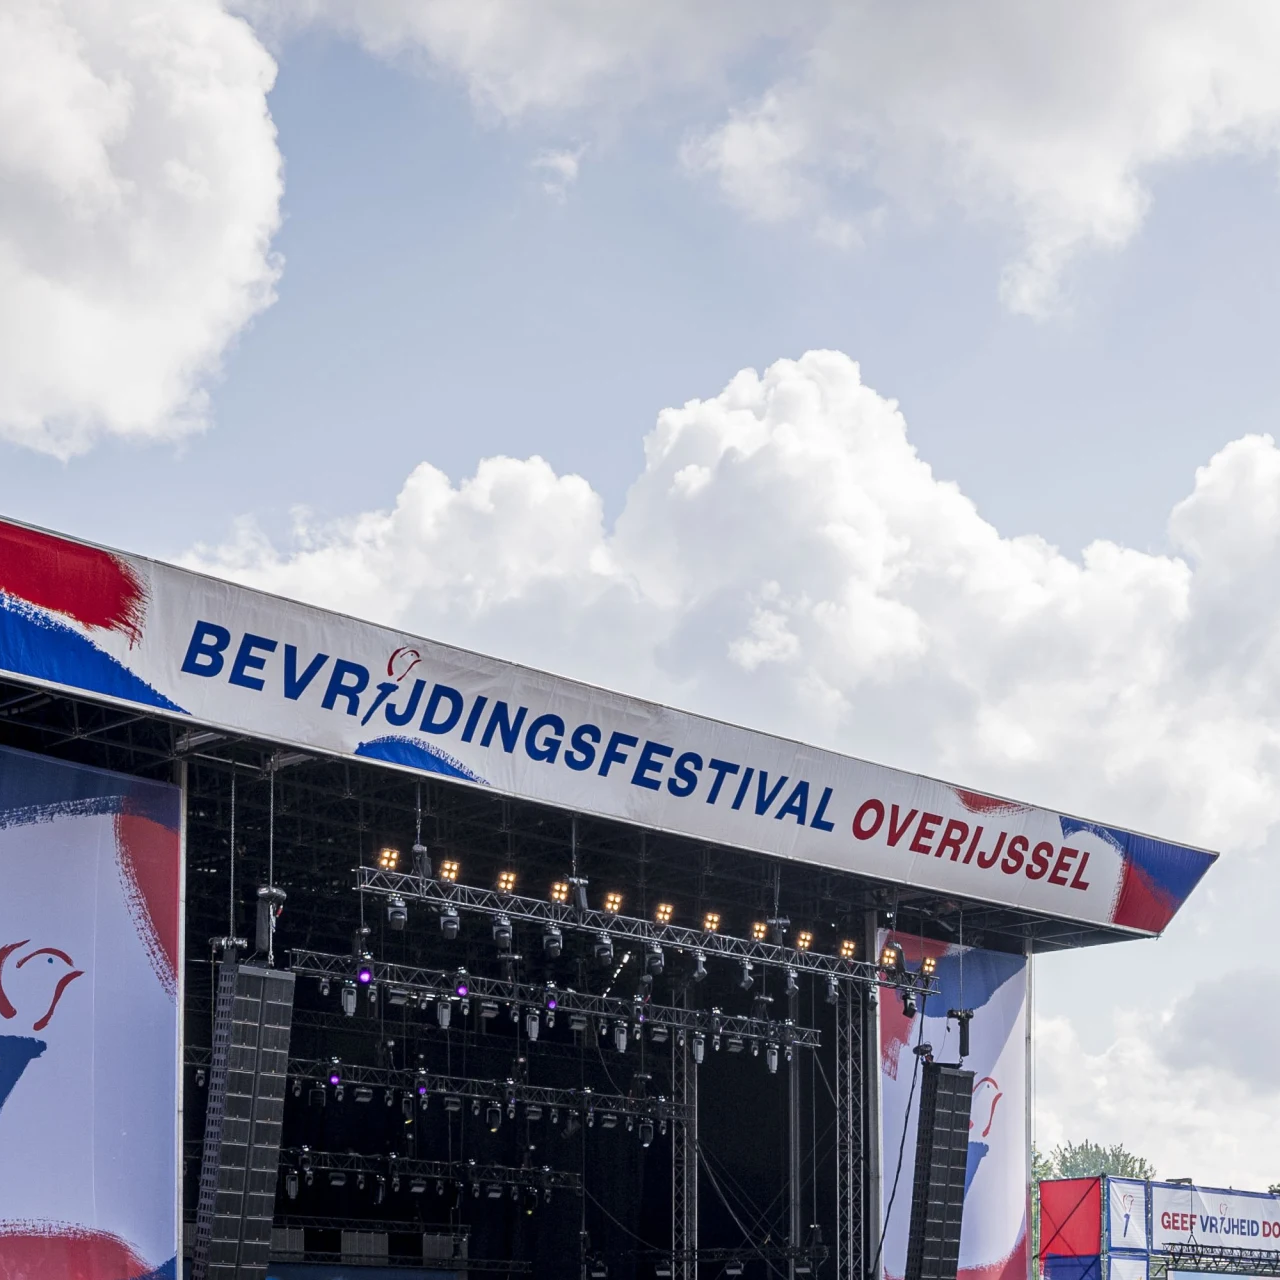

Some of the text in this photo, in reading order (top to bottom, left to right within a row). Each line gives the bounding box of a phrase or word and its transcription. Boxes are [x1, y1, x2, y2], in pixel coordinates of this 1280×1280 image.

[180, 620, 1090, 891] BEVRIJDINGSFESTIVAL OVERIJSSEL
[1161, 1211, 1197, 1232] GEEF
[1199, 1214, 1260, 1237] VRIJHEID
